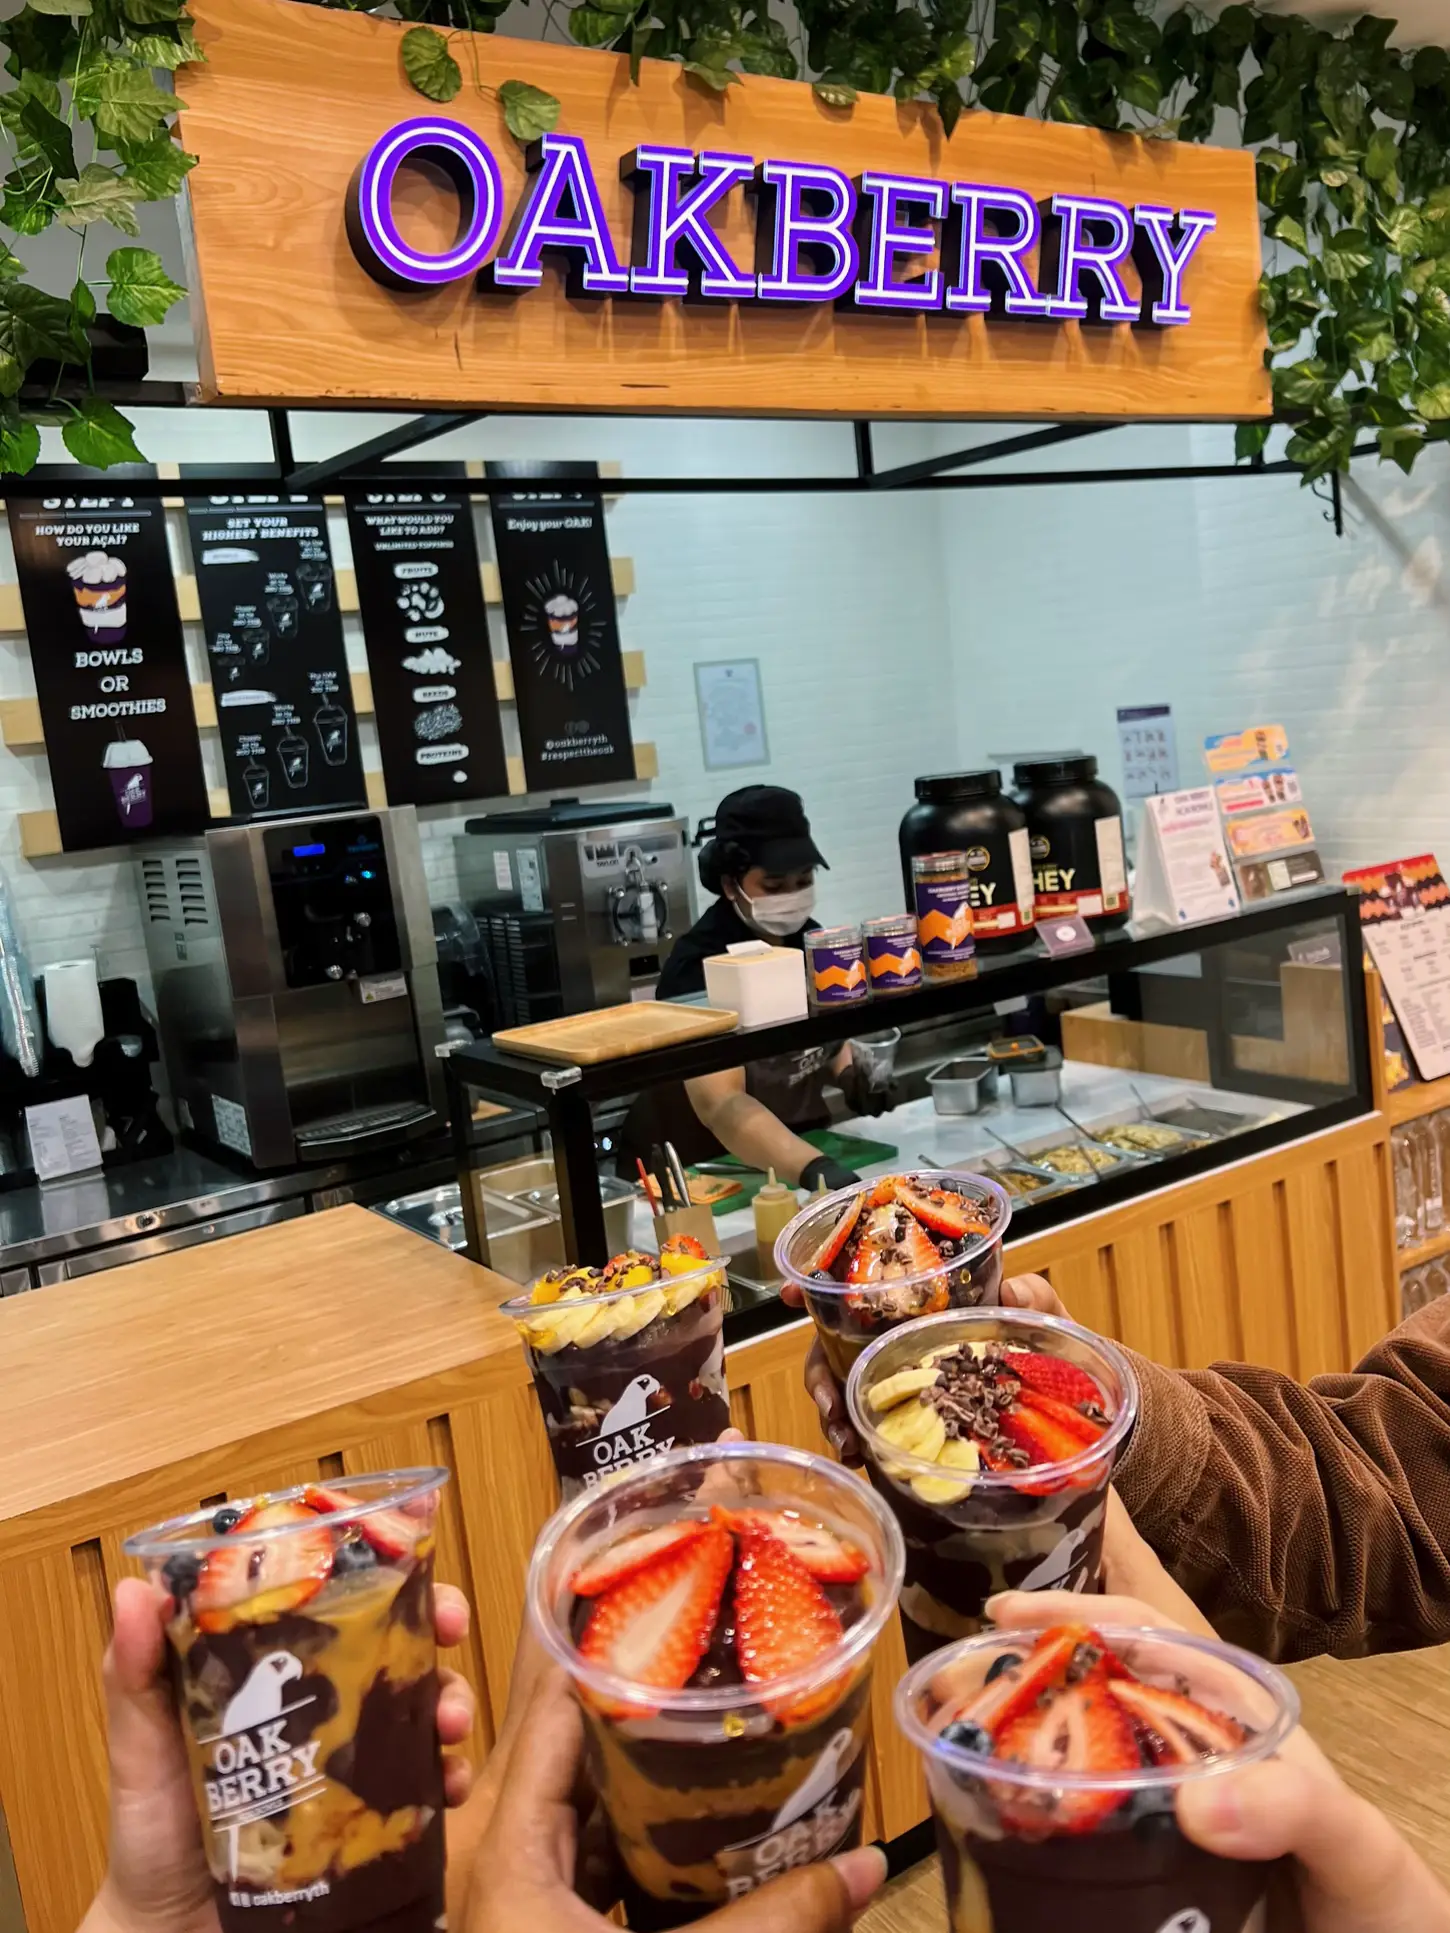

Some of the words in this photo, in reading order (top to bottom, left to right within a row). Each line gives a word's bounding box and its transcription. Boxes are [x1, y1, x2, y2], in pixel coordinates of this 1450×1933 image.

[354, 117, 1217, 325] OAKBERRY
[35, 525, 65, 536] HOW
[66, 525, 84, 535] DO
[85, 524, 111, 534] YOU
[111, 522, 140, 533] LIKE
[227, 518, 250, 529] SET
[252, 517, 288, 528] YOUR
[365, 515, 396, 526] WHAT
[397, 515, 433, 525] WOULD
[434, 514, 454, 524] YOU
[507, 518, 540, 532] Enjoy
[539, 519, 564, 532] your
[202, 529, 258, 541] HIGHEST
[259, 527, 319, 539] BENEFITS
[380, 526, 404, 536] LIKE
[404, 526, 418, 535] TO
[56, 536, 90, 547] YOUR
[75, 648, 143, 668] BOWLS
[100, 675, 129, 693] OR
[70, 698, 166, 720] SMOOTHIES
[1033, 869, 1075, 894] HEY
[594, 1422, 655, 1465] OAK
[215, 1719, 292, 1774] OAK
[205, 1740, 321, 1812] BERRY
